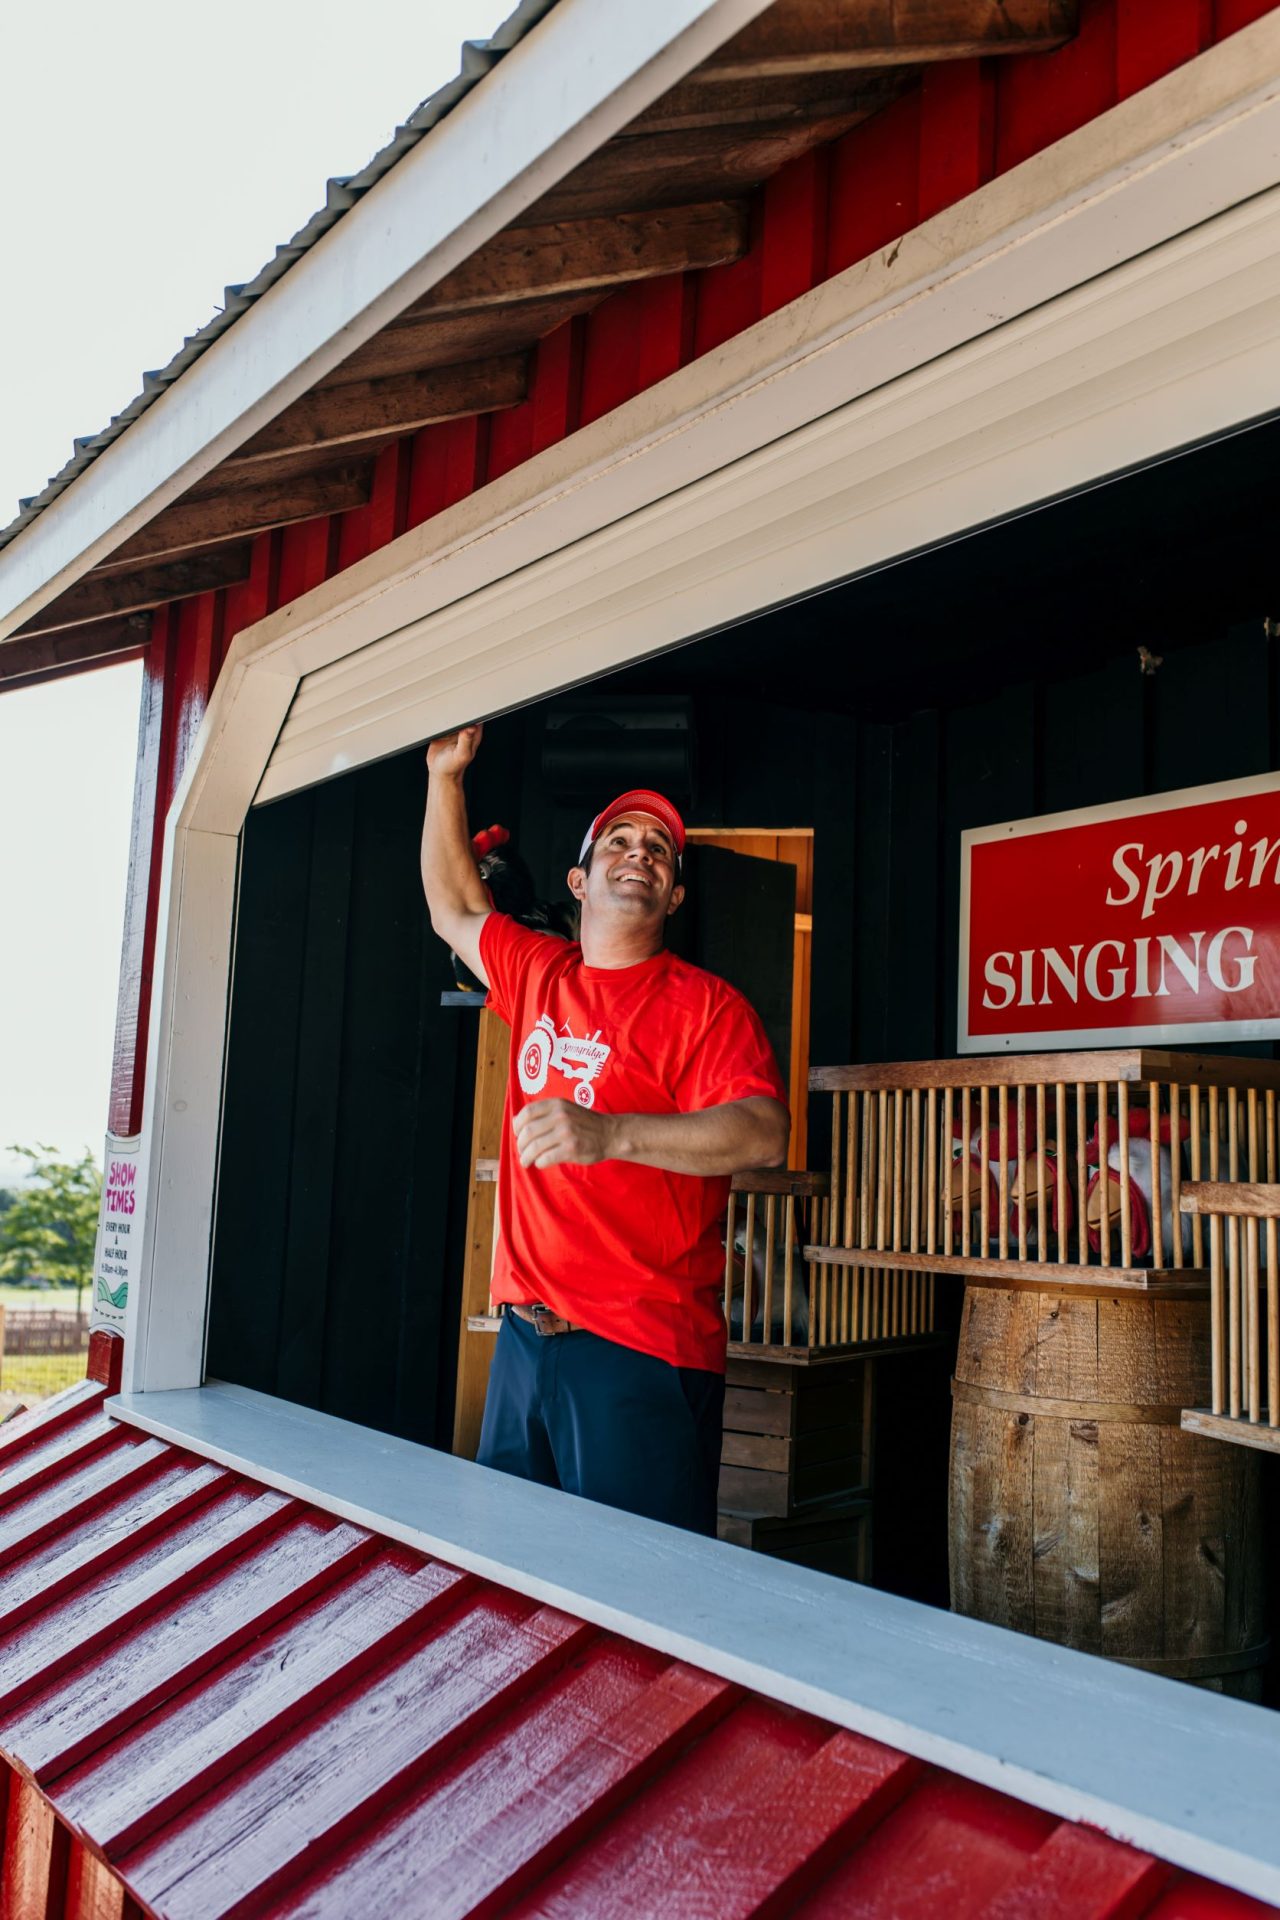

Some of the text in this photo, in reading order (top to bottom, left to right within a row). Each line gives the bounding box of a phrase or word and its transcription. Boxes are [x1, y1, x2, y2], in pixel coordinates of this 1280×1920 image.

[982, 926, 1258, 1010] SINGING
[109, 1161, 136, 1187] SHOW
[106, 1188, 135, 1215] TIMES
[105, 1221, 130, 1234] EVERY HOUR
[105, 1248, 127, 1260] HALF HOUR
